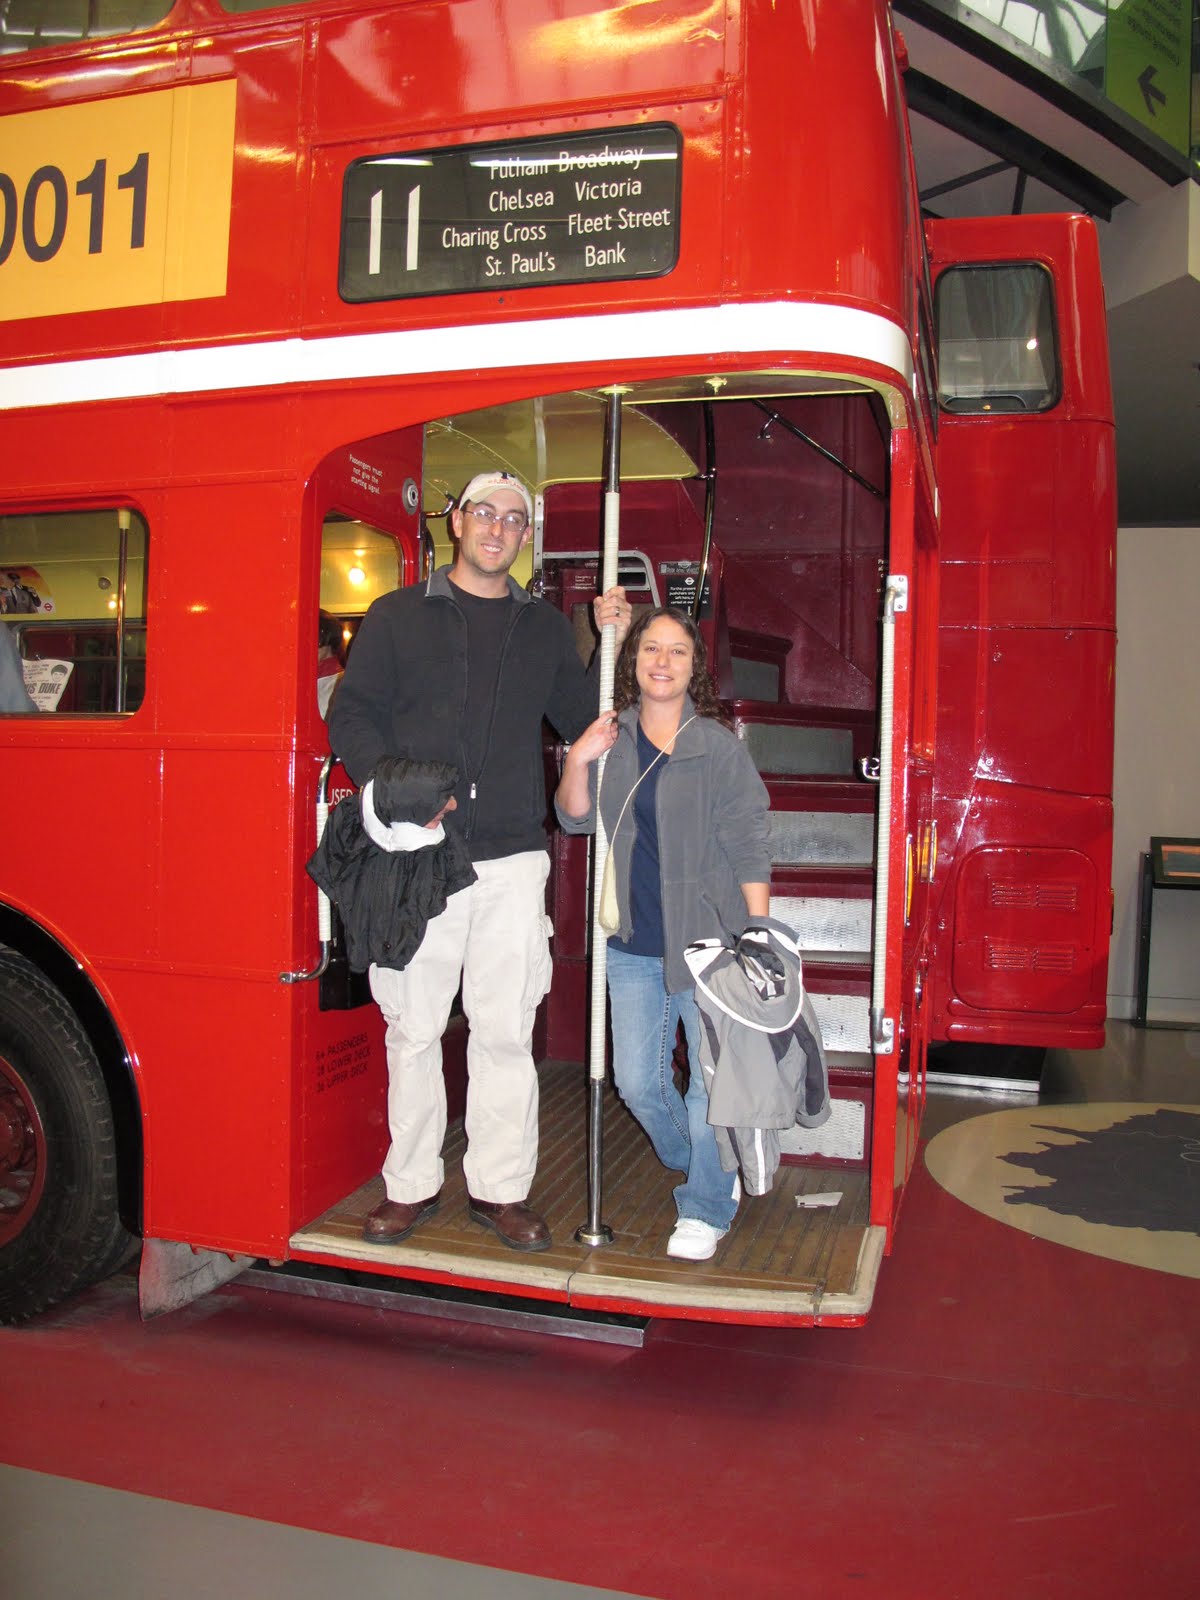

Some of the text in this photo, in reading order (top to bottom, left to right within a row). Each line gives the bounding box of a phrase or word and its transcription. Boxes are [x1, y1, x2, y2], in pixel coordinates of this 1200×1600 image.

[559, 145, 644, 172] Broadway
[489, 178, 642, 212] Chelsea Victoria
[369, 185, 421, 275] 11
[442, 208, 671, 250] Charing Cross Fleet Street
[485, 242, 626, 277] St. Paul's Bank
[38, 683, 62, 694] DUKE
